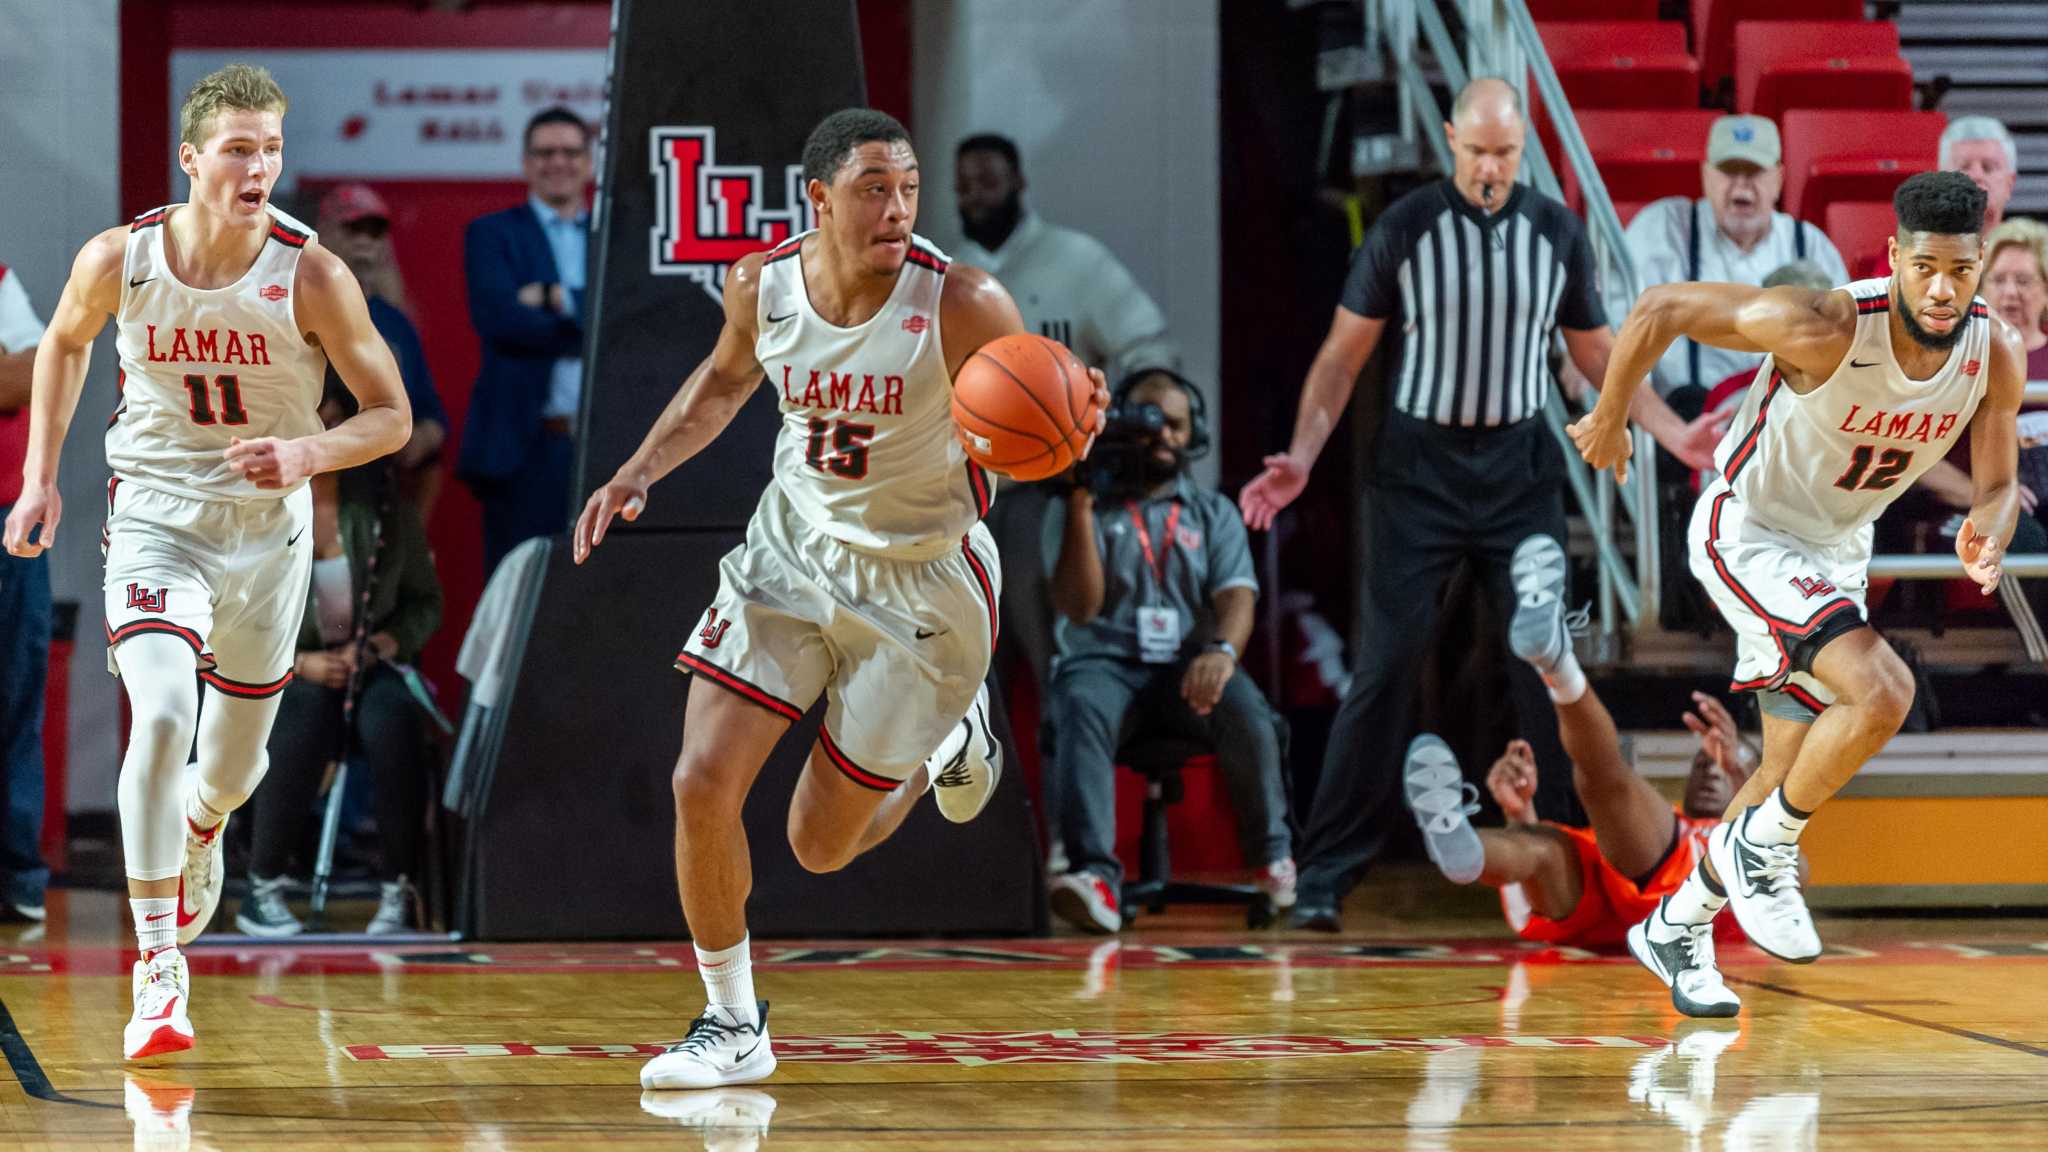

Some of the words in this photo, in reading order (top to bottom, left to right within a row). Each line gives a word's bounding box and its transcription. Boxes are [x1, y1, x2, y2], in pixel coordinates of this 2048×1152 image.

[147, 324, 272, 366] LAMAR
[183, 373, 249, 426] 11
[783, 364, 904, 416] LAMAR
[805, 416, 876, 481] 15
[1833, 444, 1915, 492] 12
